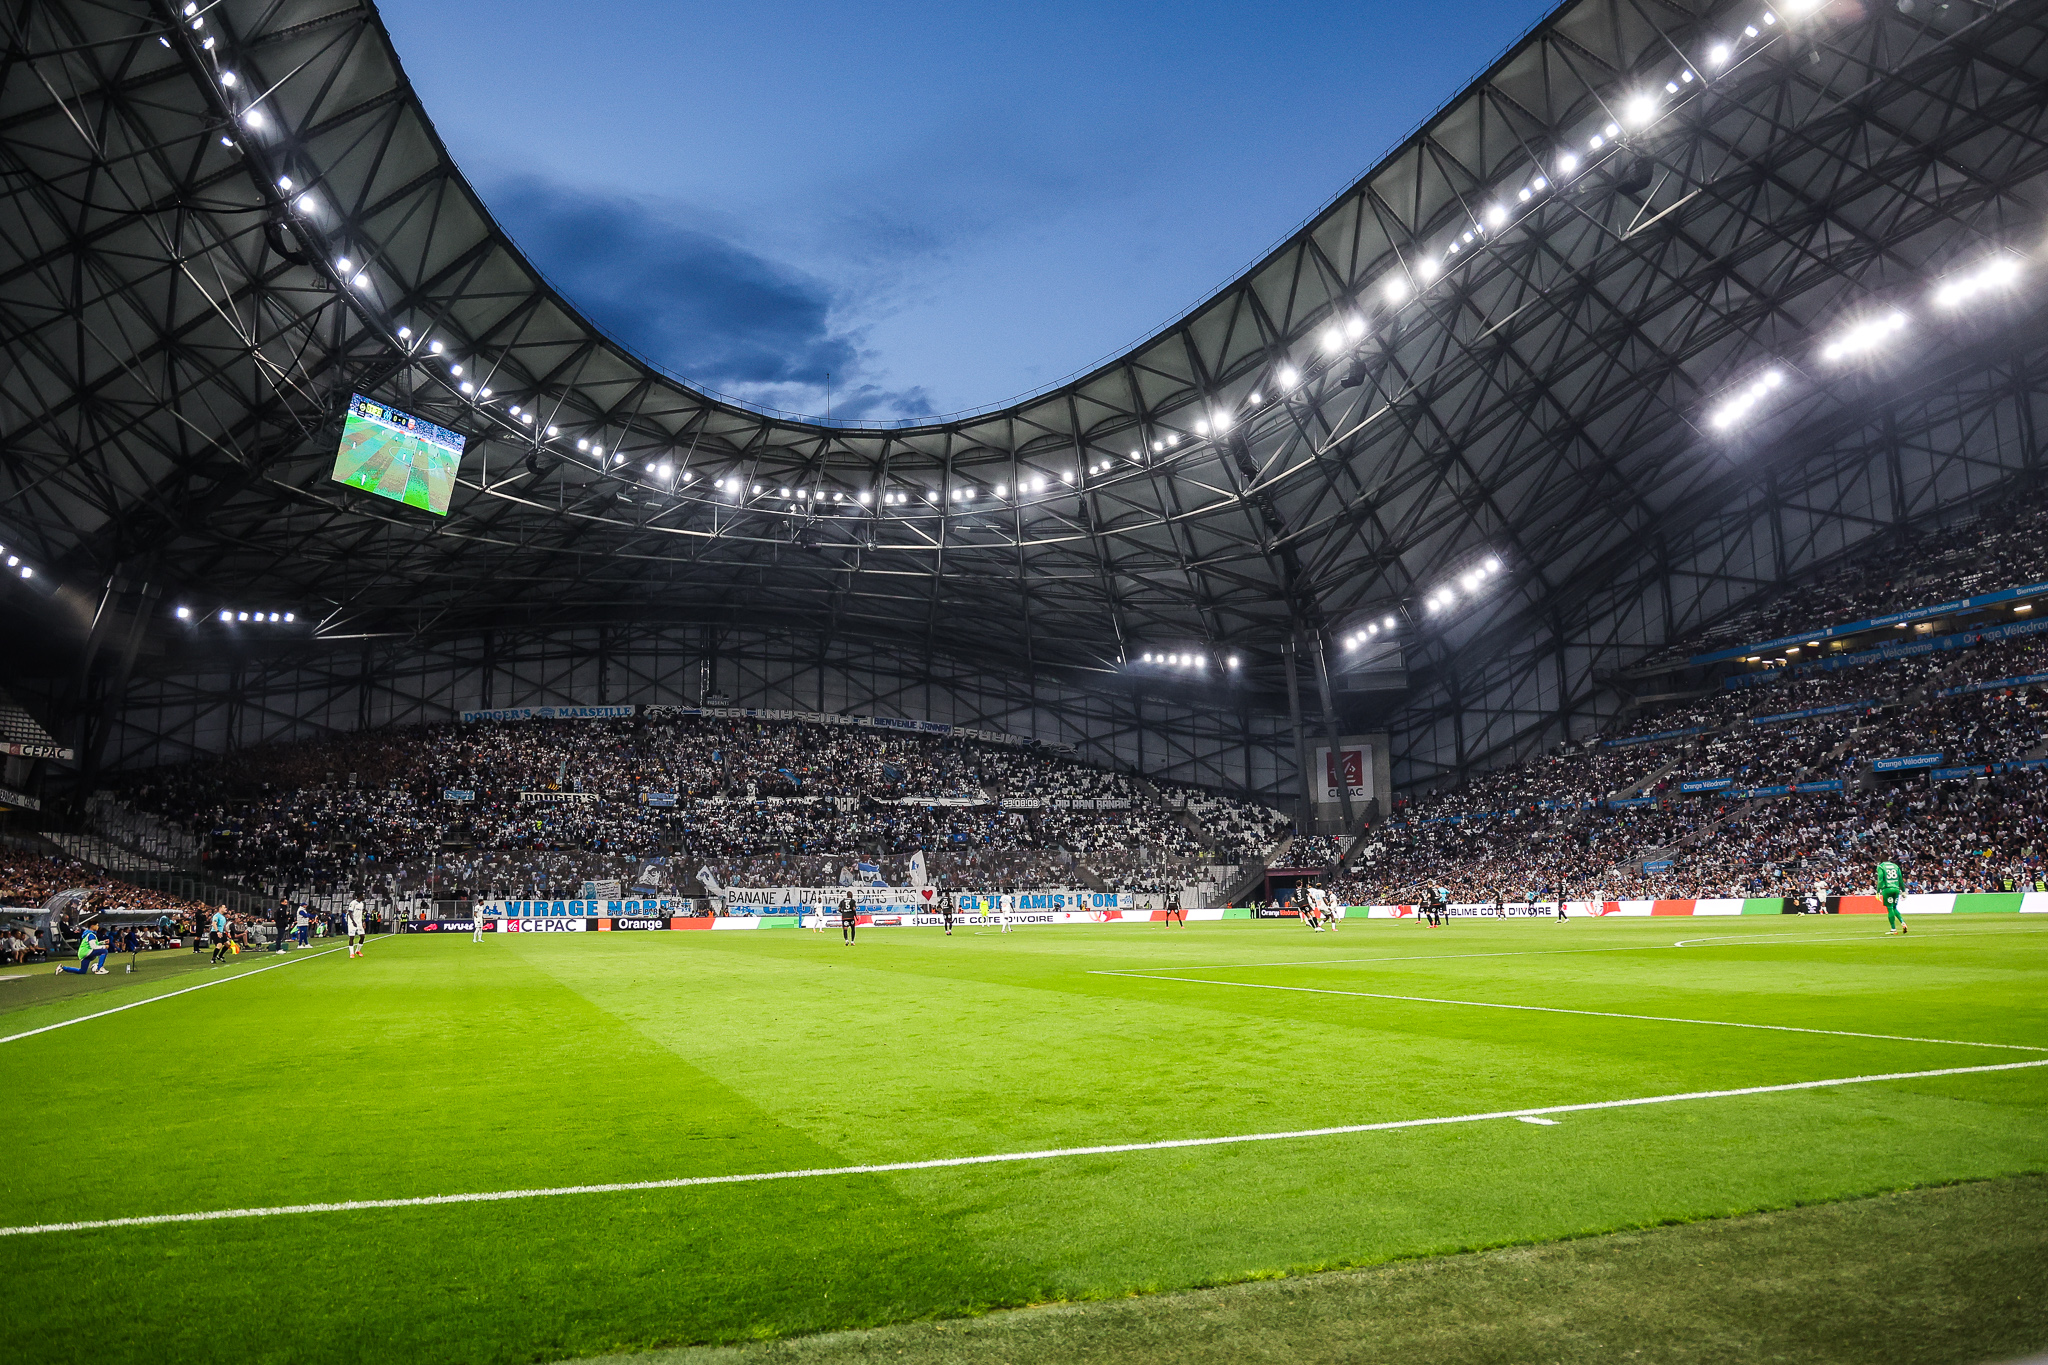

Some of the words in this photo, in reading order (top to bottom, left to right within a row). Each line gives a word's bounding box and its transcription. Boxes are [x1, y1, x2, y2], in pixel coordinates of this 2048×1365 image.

[1928, 602, 1959, 614] Vélodrome
[1963, 630, 2002, 643] Ornge
[1848, 653, 1881, 664] Orange
[464, 709, 531, 722] DODGER'S
[559, 707, 632, 717] MARSEILLE
[874, 717, 917, 729] BIENVENUE
[23, 745, 66, 759] CEPAC
[1878, 760, 1902, 769] Orange
[1328, 787, 1364, 798] CEAC
[1683, 783, 1702, 791] Orange
[1886, 869, 1898, 880] 38
[729, 890, 776, 904] BANANE
[784, 889, 792, 905] À
[857, 889, 887, 904] DANS
[894, 889, 917, 903] NOS
[1018, 894, 1065, 909] AMIS
[1076, 893, 1117, 908] L'OM
[505, 900, 599, 917] VIRAGE
[1261, 909, 1280, 918] Orange
[1439, 908, 1478, 916] SUBLIME
[1480, 905, 1504, 916] CÔT
[1508, 906, 1552, 916] D'IVOIRE
[521, 919, 577, 932] CEPAC
[618, 918, 663, 931] Orange
[912, 916, 965, 925] SUBLME
